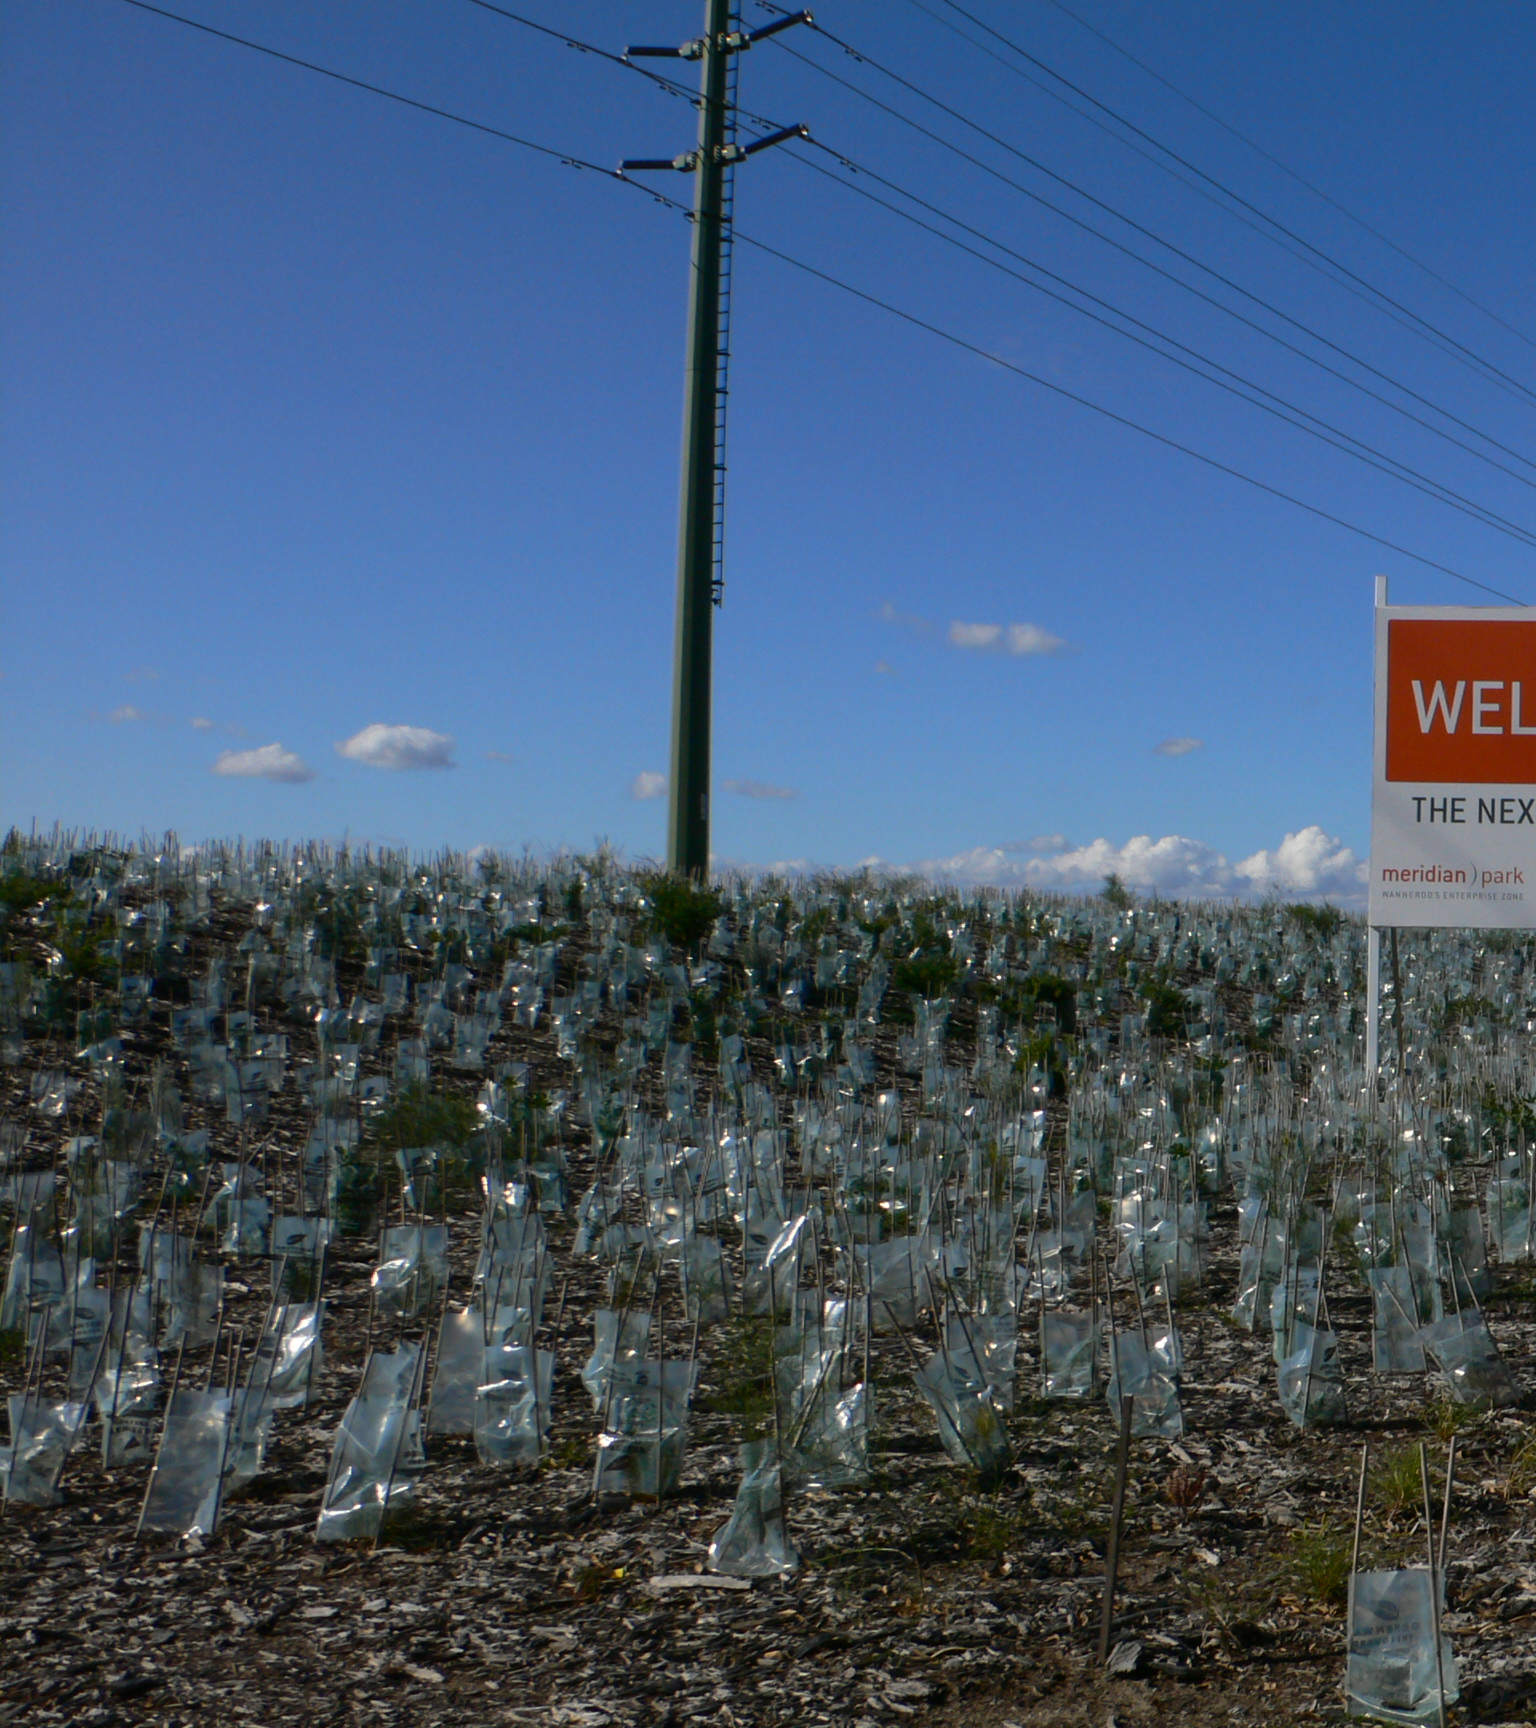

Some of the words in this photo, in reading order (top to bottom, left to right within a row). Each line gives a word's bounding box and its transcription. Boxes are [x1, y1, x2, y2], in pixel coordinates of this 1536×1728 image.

[1412, 797, 1466, 823] THE
[1382, 865, 1466, 883] meridian
[1481, 867, 1524, 888] park
[1443, 892, 1498, 900] ENTERPRISE
[1501, 892, 1525, 900] ZONE
